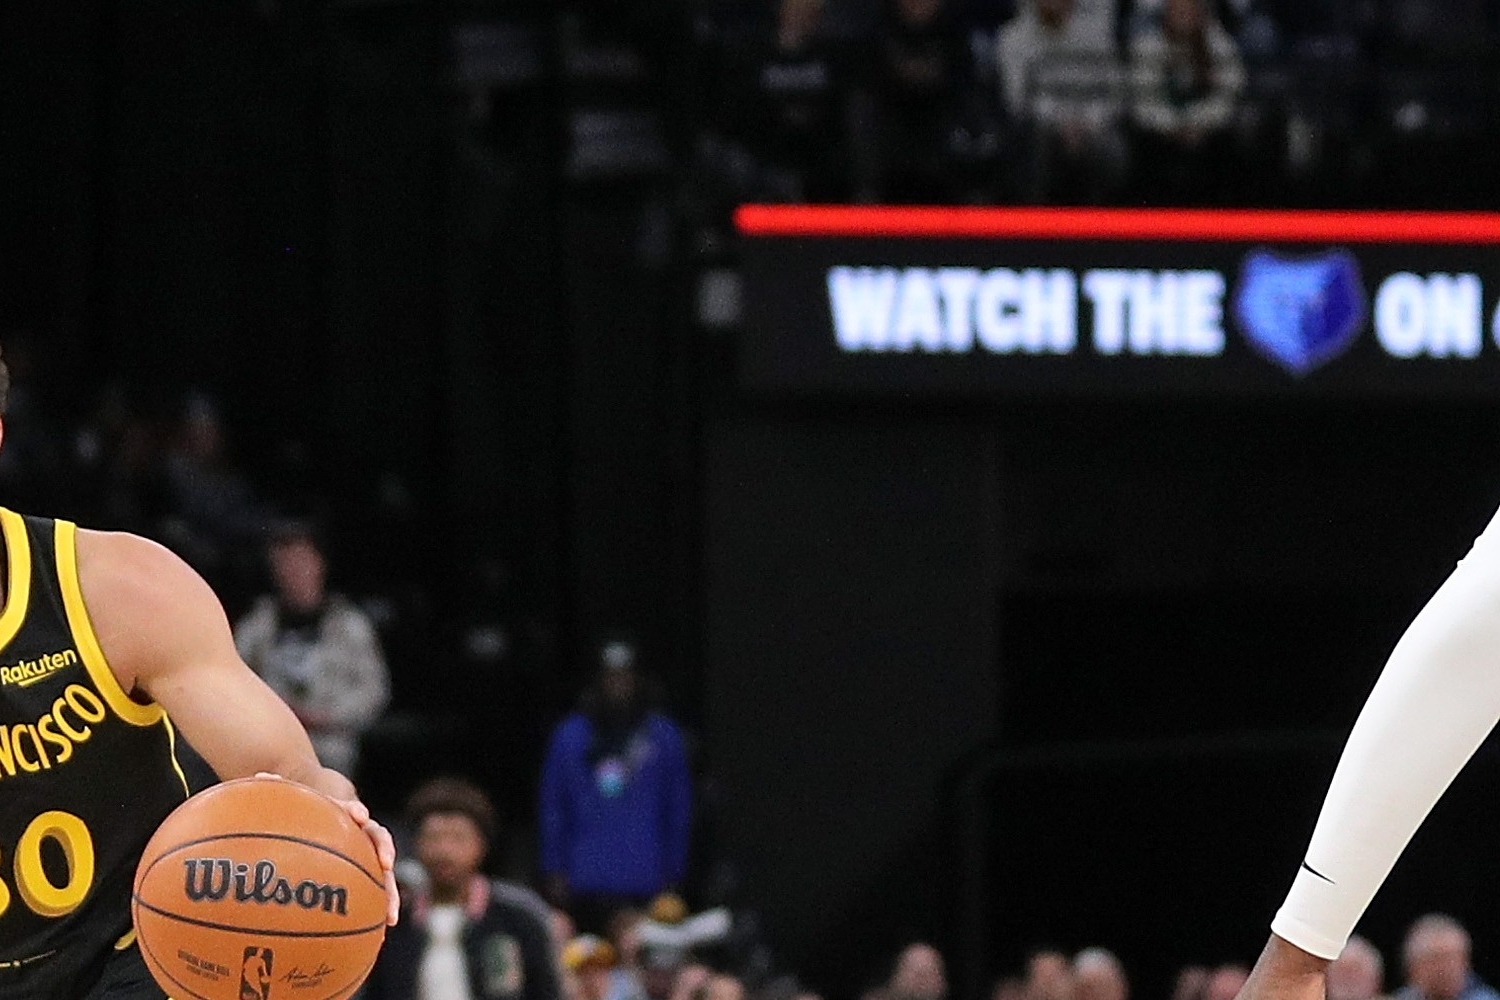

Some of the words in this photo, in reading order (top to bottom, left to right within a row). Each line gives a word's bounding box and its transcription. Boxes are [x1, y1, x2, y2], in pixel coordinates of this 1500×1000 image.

[827, 266, 1077, 354] WATCH
[1083, 269, 1224, 356] THE
[1376, 273, 1483, 358] ON
[0, 649, 77, 686] Rakuten
[184, 858, 348, 916] Wilson
